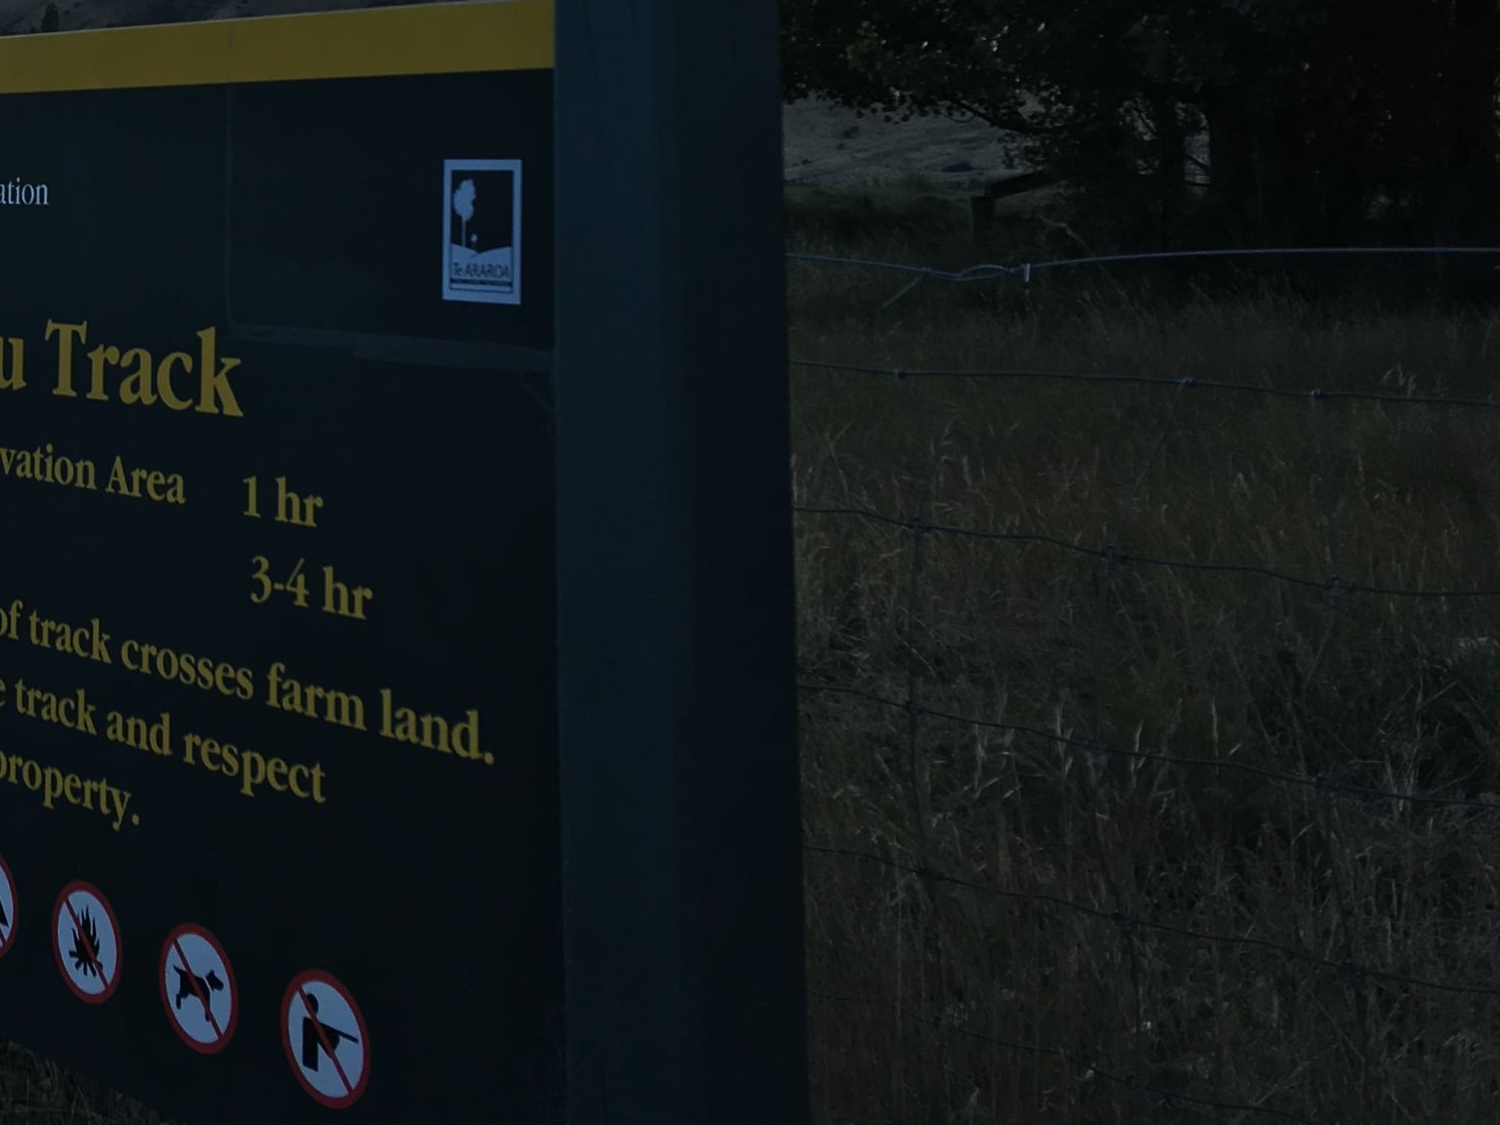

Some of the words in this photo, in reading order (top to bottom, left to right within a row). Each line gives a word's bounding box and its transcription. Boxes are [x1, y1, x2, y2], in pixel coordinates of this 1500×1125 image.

[45, 319, 243, 416] Track
[106, 456, 186, 505] Area
[243, 476, 259, 518] 1
[275, 480, 321, 528] hr
[251, 556, 308, 607] 3-4
[323, 565, 373, 620] hr
[29, 612, 111, 663] track
[121, 640, 253, 699] crosses
[266, 663, 367, 731] farm
[379, 689, 495, 765] land.
[15, 679, 96, 734] track
[107, 712, 171, 755] and
[183, 733, 326, 803] respect
